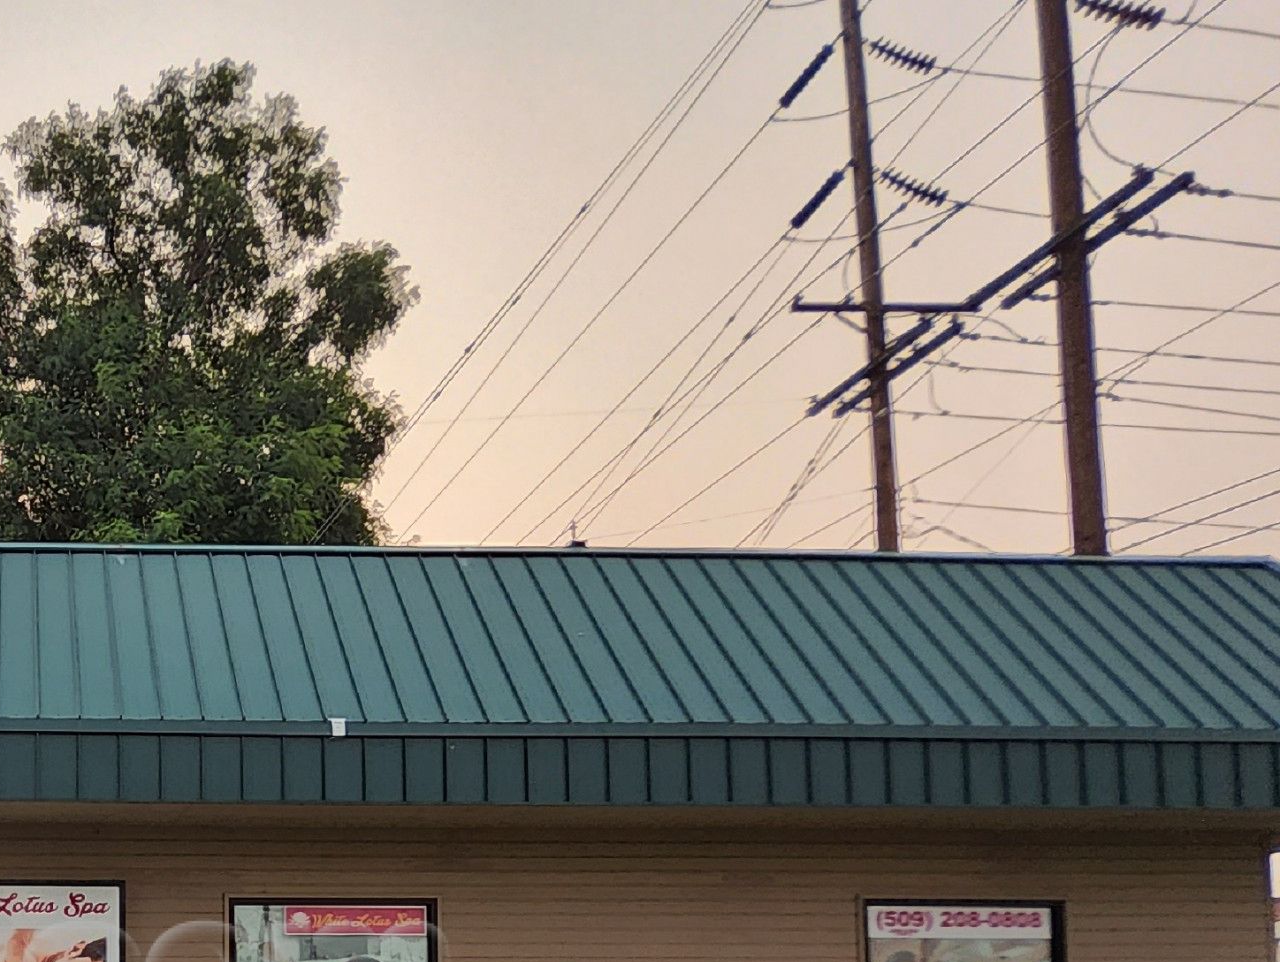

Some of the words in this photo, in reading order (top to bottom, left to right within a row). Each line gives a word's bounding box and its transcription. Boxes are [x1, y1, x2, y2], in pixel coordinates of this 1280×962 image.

[64, 892, 110, 918] Spa
[312, 912, 350, 929] White
[351, 912, 391, 928] Lotus
[876, 910, 934, 932] (509)
